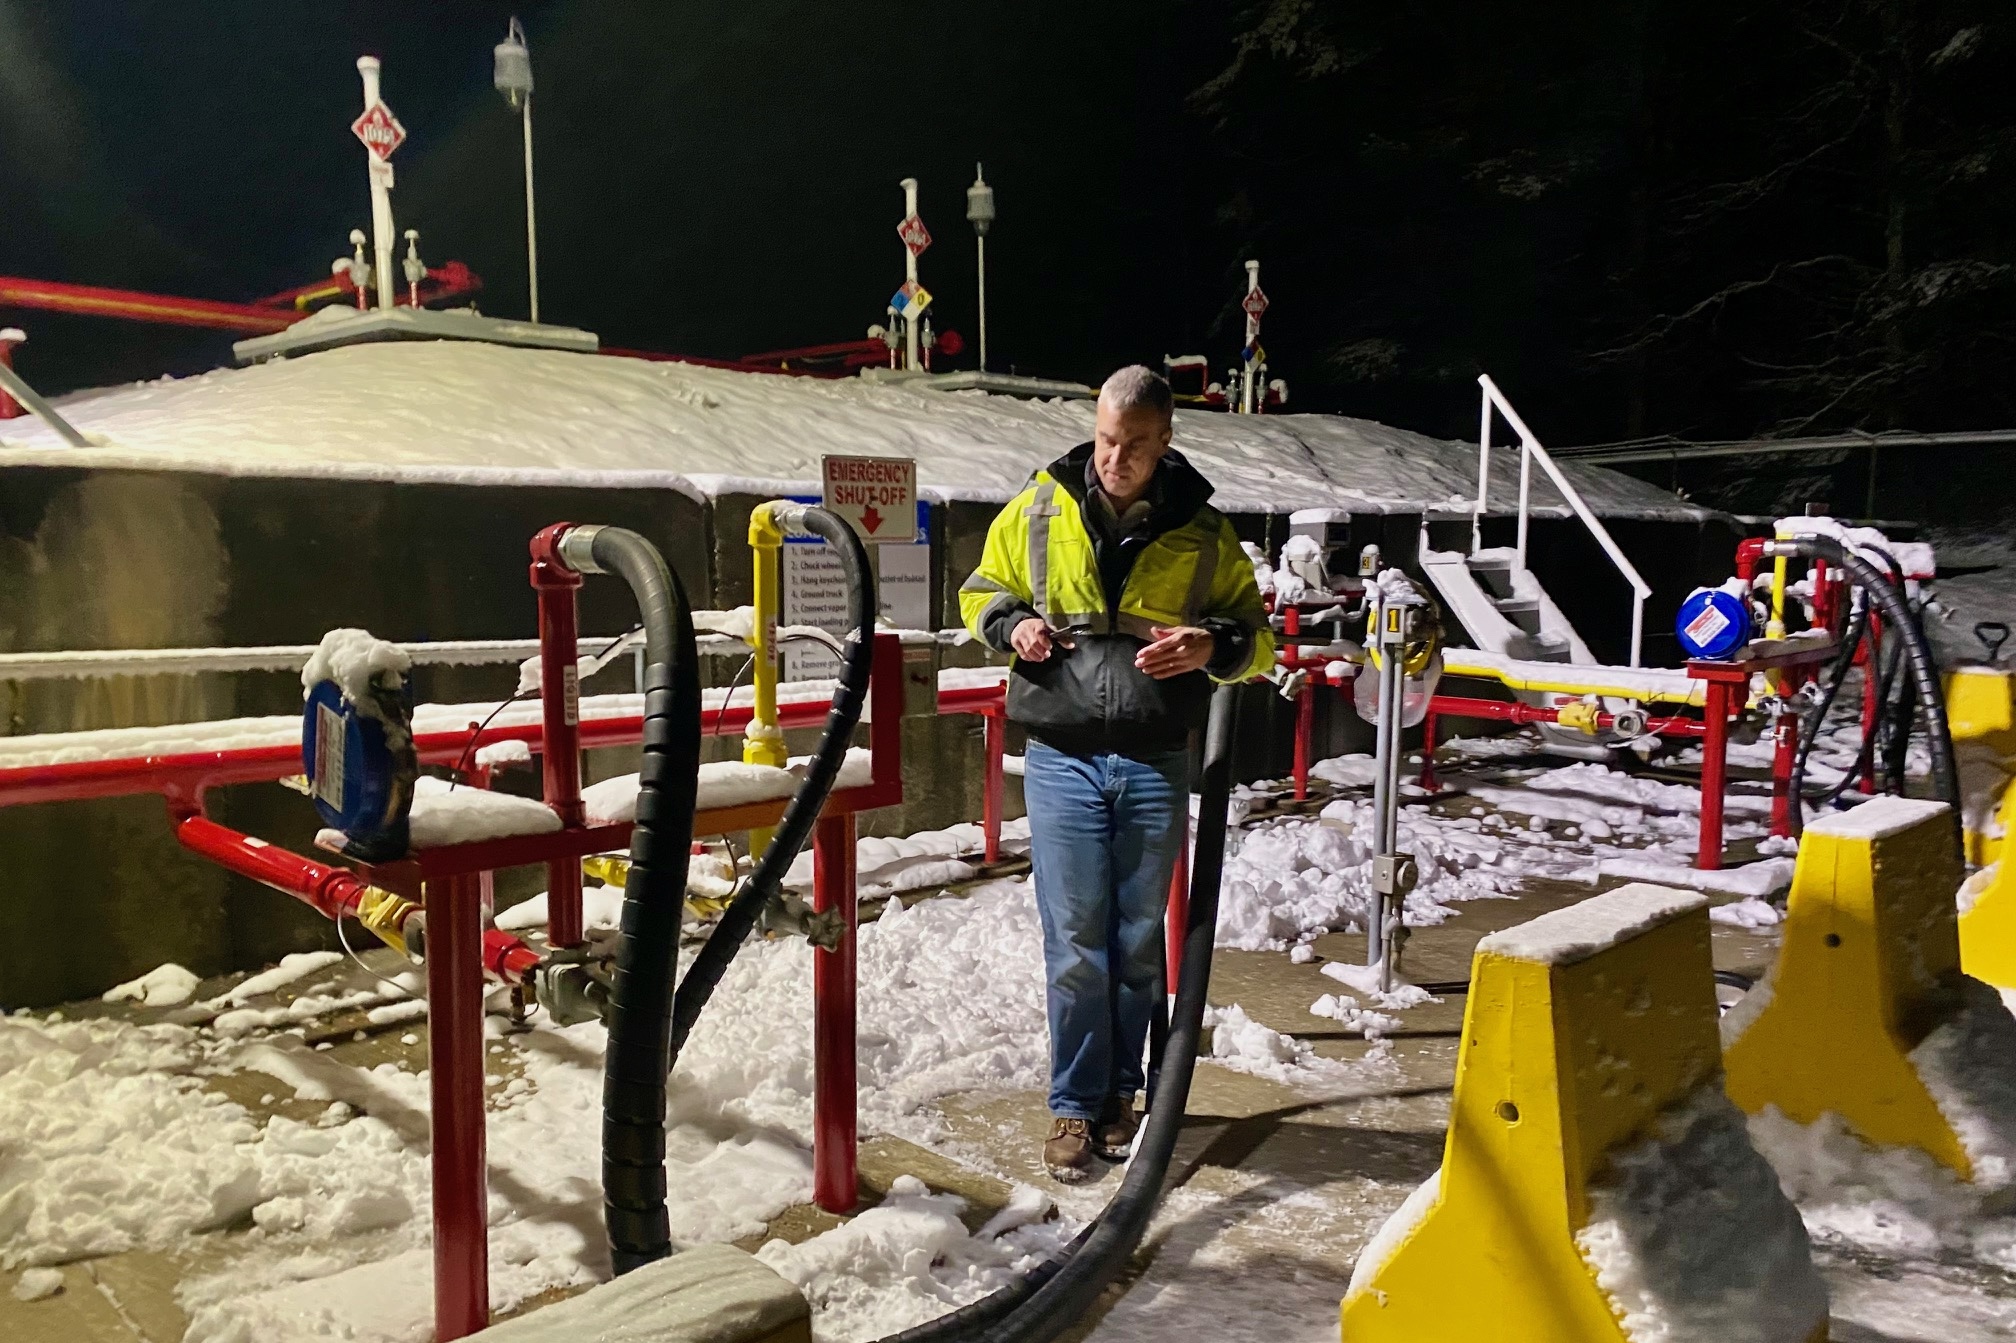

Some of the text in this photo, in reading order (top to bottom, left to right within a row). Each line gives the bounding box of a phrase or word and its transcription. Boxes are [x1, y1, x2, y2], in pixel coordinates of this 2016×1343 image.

[829, 461, 910, 483] EMERGENCY
[835, 485, 907, 505] SHUT-OFF
[1389, 610, 1398, 632] 1
